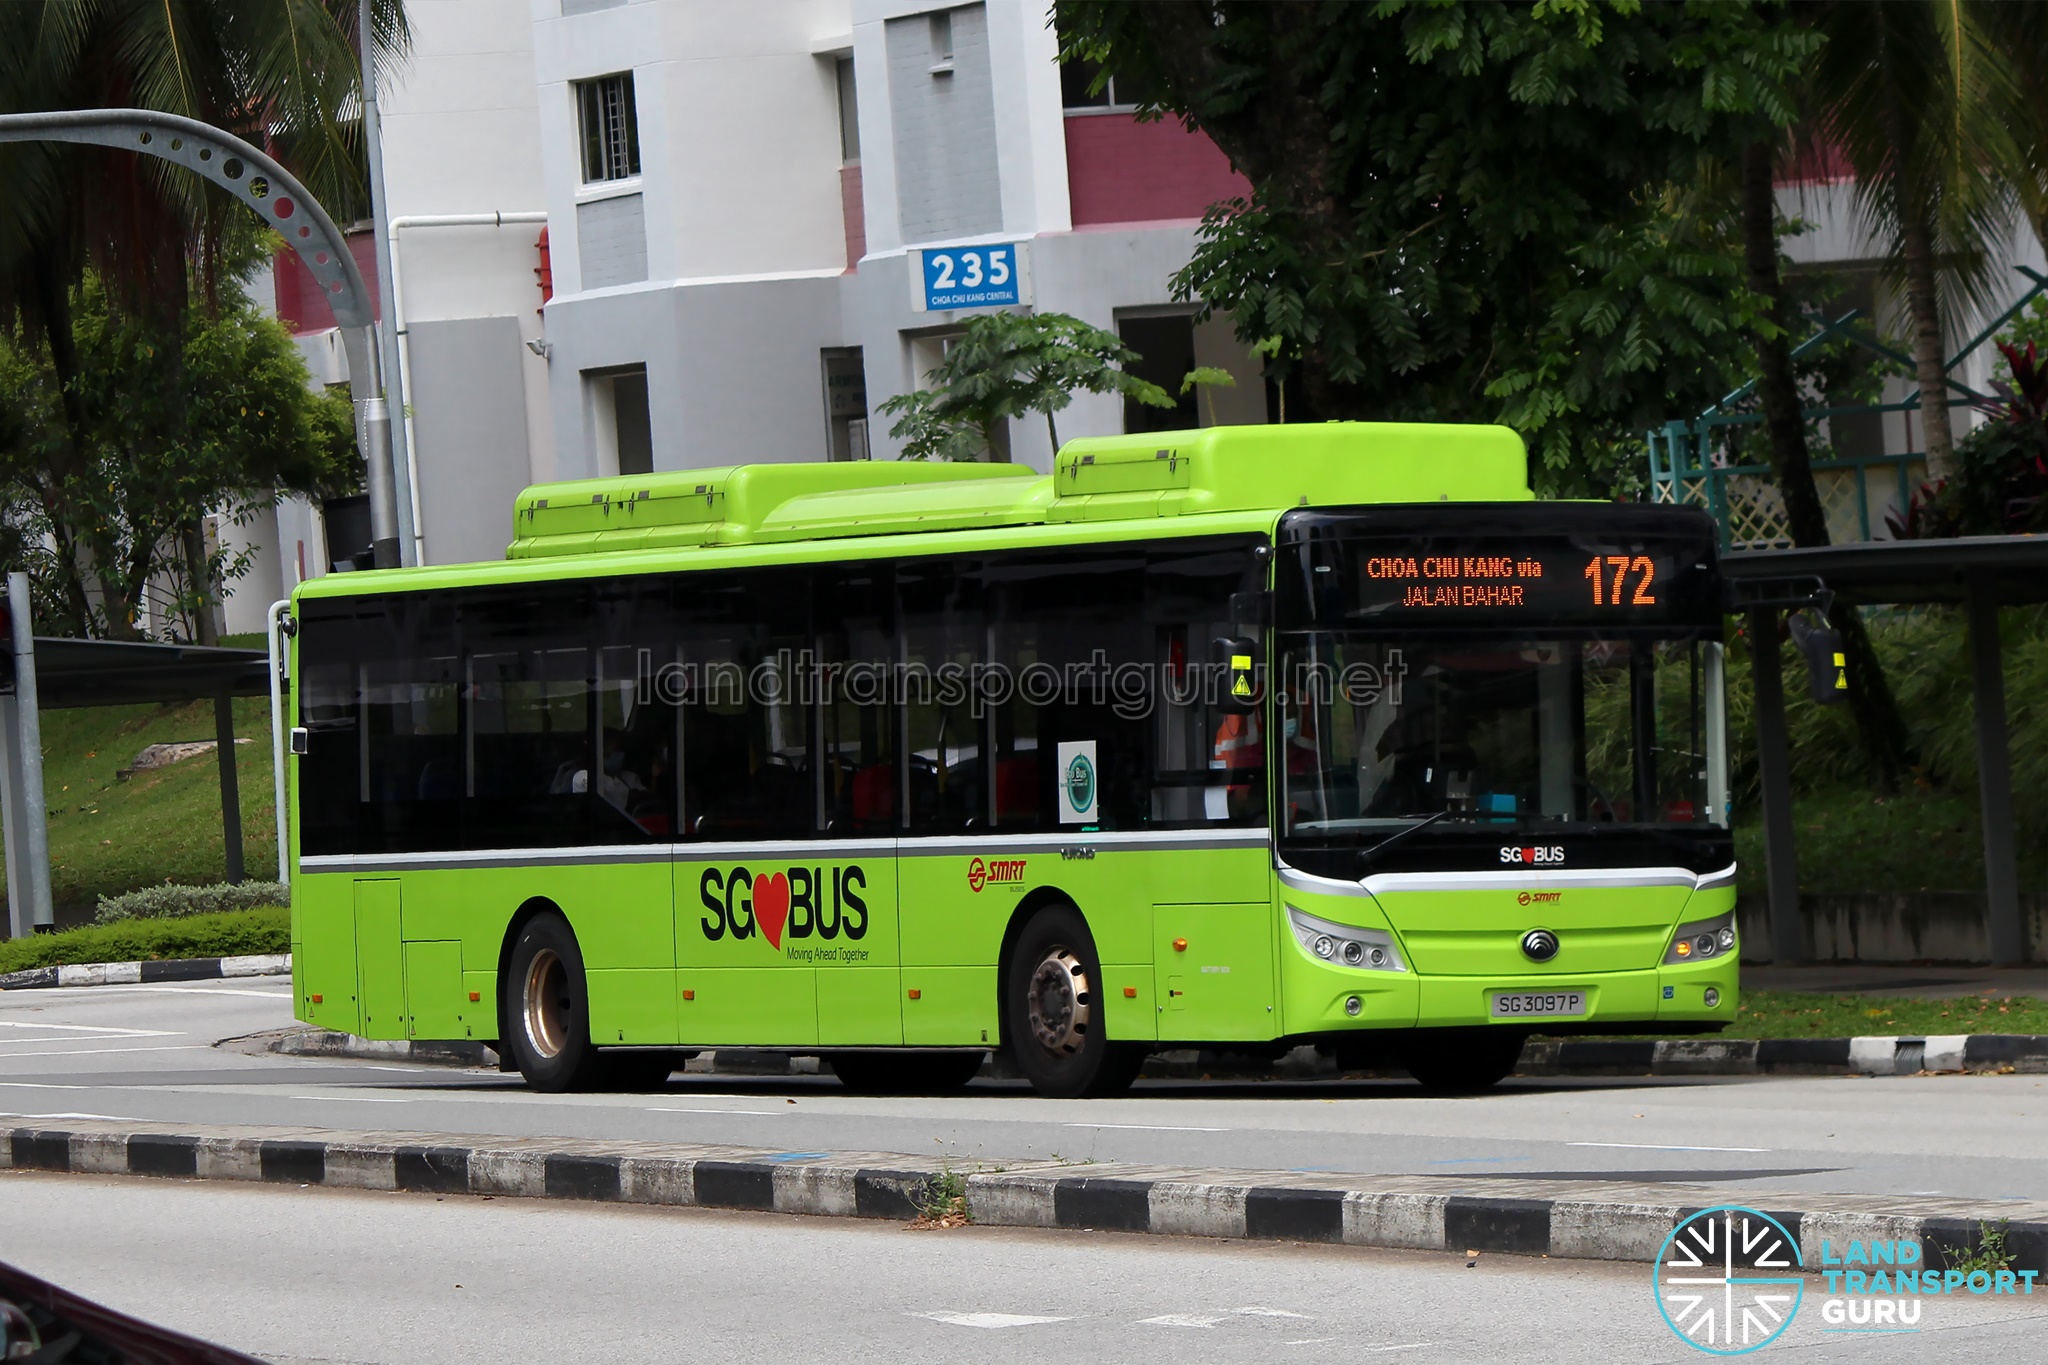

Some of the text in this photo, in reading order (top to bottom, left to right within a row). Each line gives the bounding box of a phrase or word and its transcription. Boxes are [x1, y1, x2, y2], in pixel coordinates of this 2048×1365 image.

[932, 250, 1010, 289] 235
[932, 291, 1013, 305] CHOA CHU KANG CENTRAL
[1367, 557, 1542, 578] CHOA CHU KANG via
[1585, 556, 1655, 605] 172
[1403, 585, 1524, 607] JALAN BAHAR
[987, 860, 1027, 881] SMRT
[1532, 892, 1562, 902] SMRT
[787, 946, 869, 964] Moving Ahead Together
[1500, 995, 1579, 1012] SG3097P
